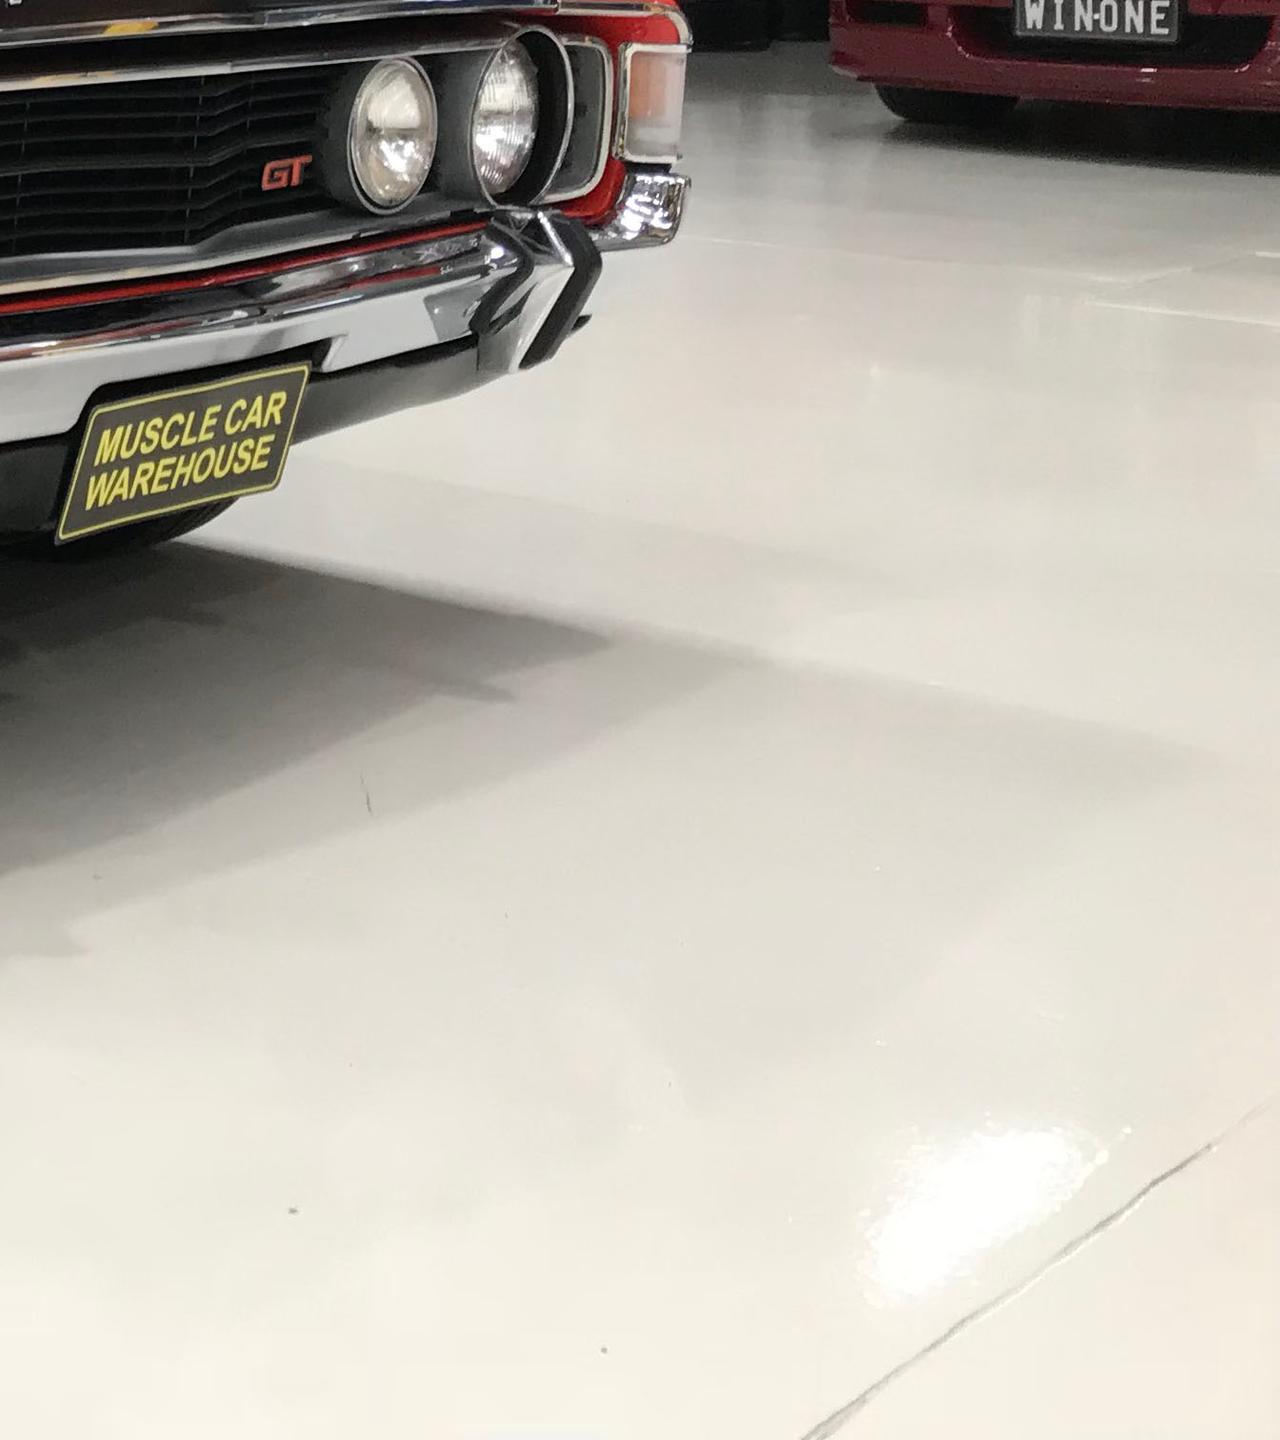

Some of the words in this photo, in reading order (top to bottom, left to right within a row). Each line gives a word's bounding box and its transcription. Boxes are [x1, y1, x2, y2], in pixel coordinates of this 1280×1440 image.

[261, 154, 313, 191] GT
[93, 403, 222, 467] MUSCLE
[223, 390, 288, 436] CAR
[84, 433, 276, 511] WAREHOUSE
